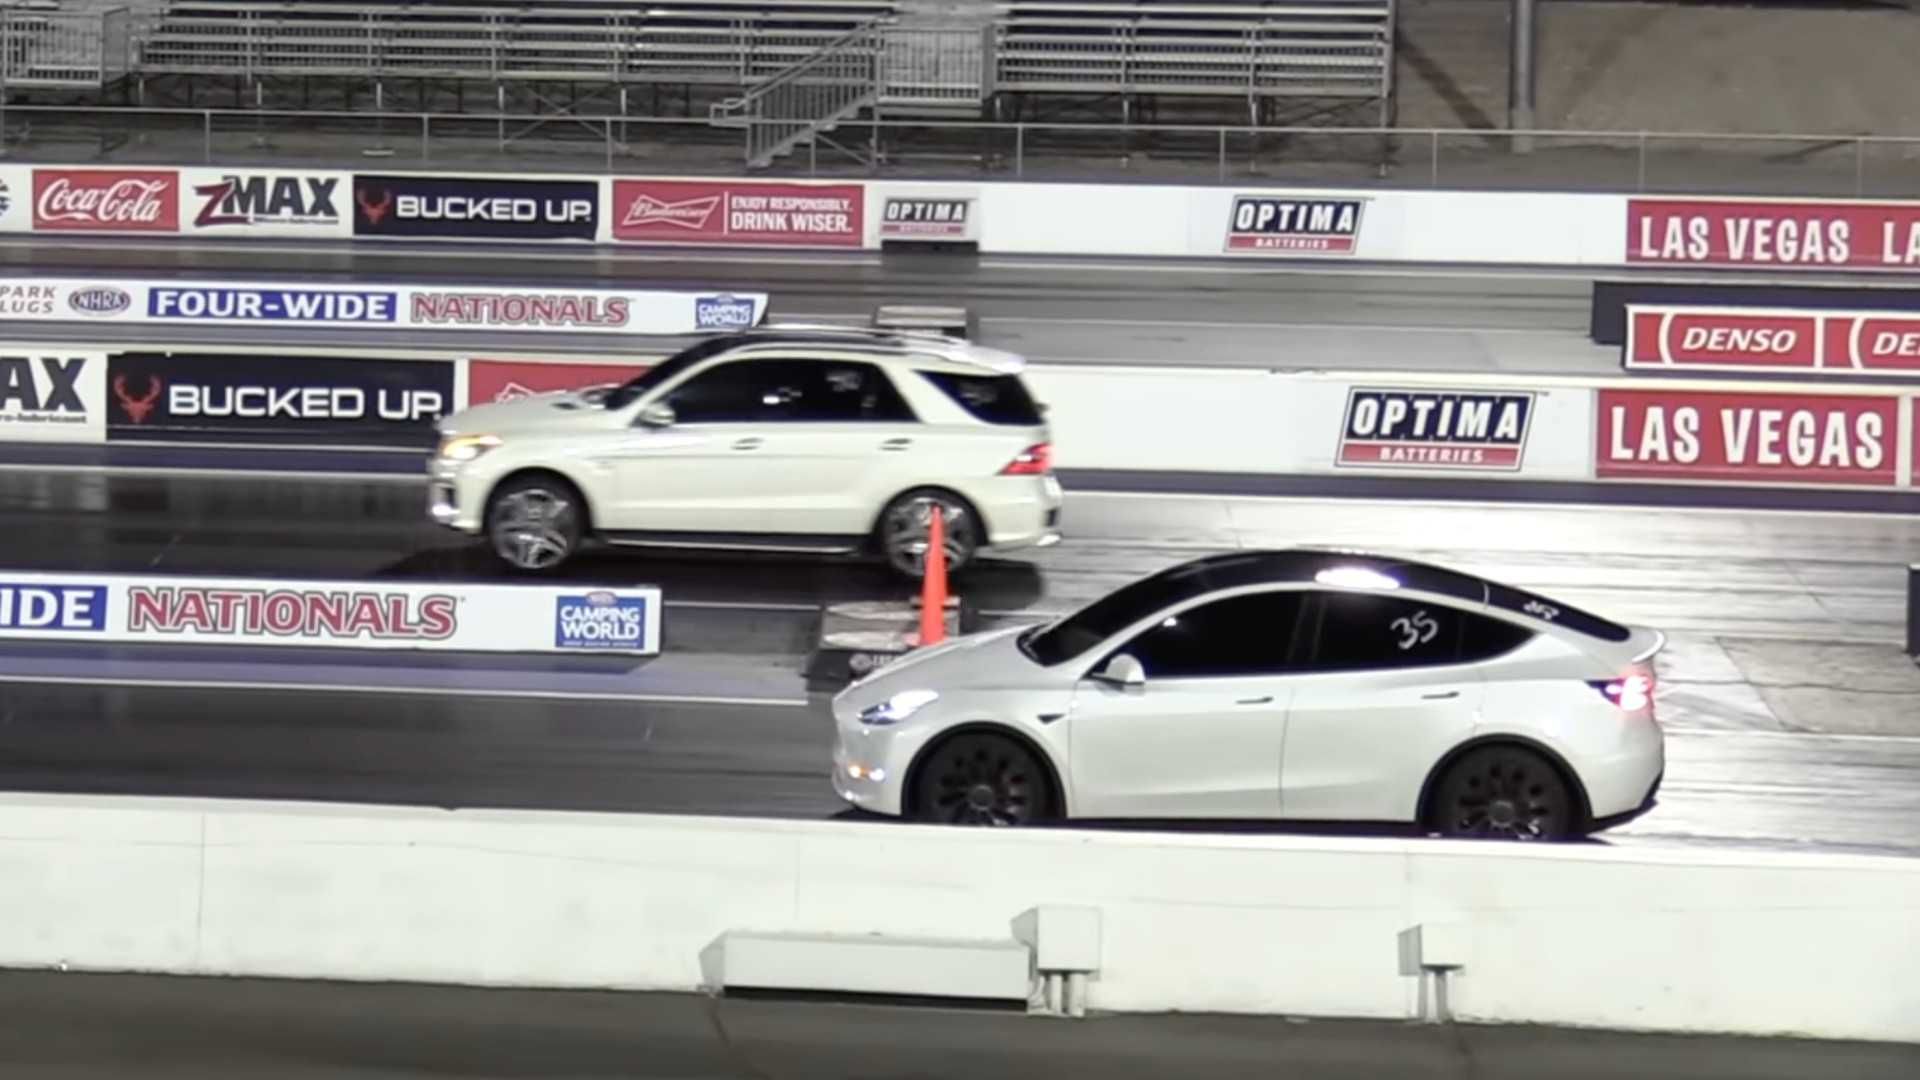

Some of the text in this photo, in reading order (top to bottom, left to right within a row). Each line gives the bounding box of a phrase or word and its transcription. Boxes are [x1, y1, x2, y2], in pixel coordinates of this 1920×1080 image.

[396, 196, 537, 221] BUCKED
[731, 196, 767, 210] ENJOY
[887, 202, 964, 220] OPTIMA
[731, 212, 853, 233] DRINK WISER.
[1236, 203, 1354, 231] OPTIMA
[1255, 237, 1329, 250] BATTERIES
[1640, 216, 1849, 264] LAS VEGAS
[156, 290, 389, 320] FOUR-WIDE
[410, 291, 630, 326] NATIONALS
[1682, 328, 1796, 355] DENSO
[1872, 332, 1920, 356] DE
[168, 385, 364, 418] BUCKED
[1350, 395, 1520, 439] OPTIMA
[1611, 406, 1883, 468] LAS VEGAS
[1379, 447, 1484, 464] BATTERIES
[128, 586, 458, 639] NATIONALS
[560, 605, 640, 622] CAMPING
[561, 621, 640, 640] WORLD
[1390, 610, 1438, 650] 35
